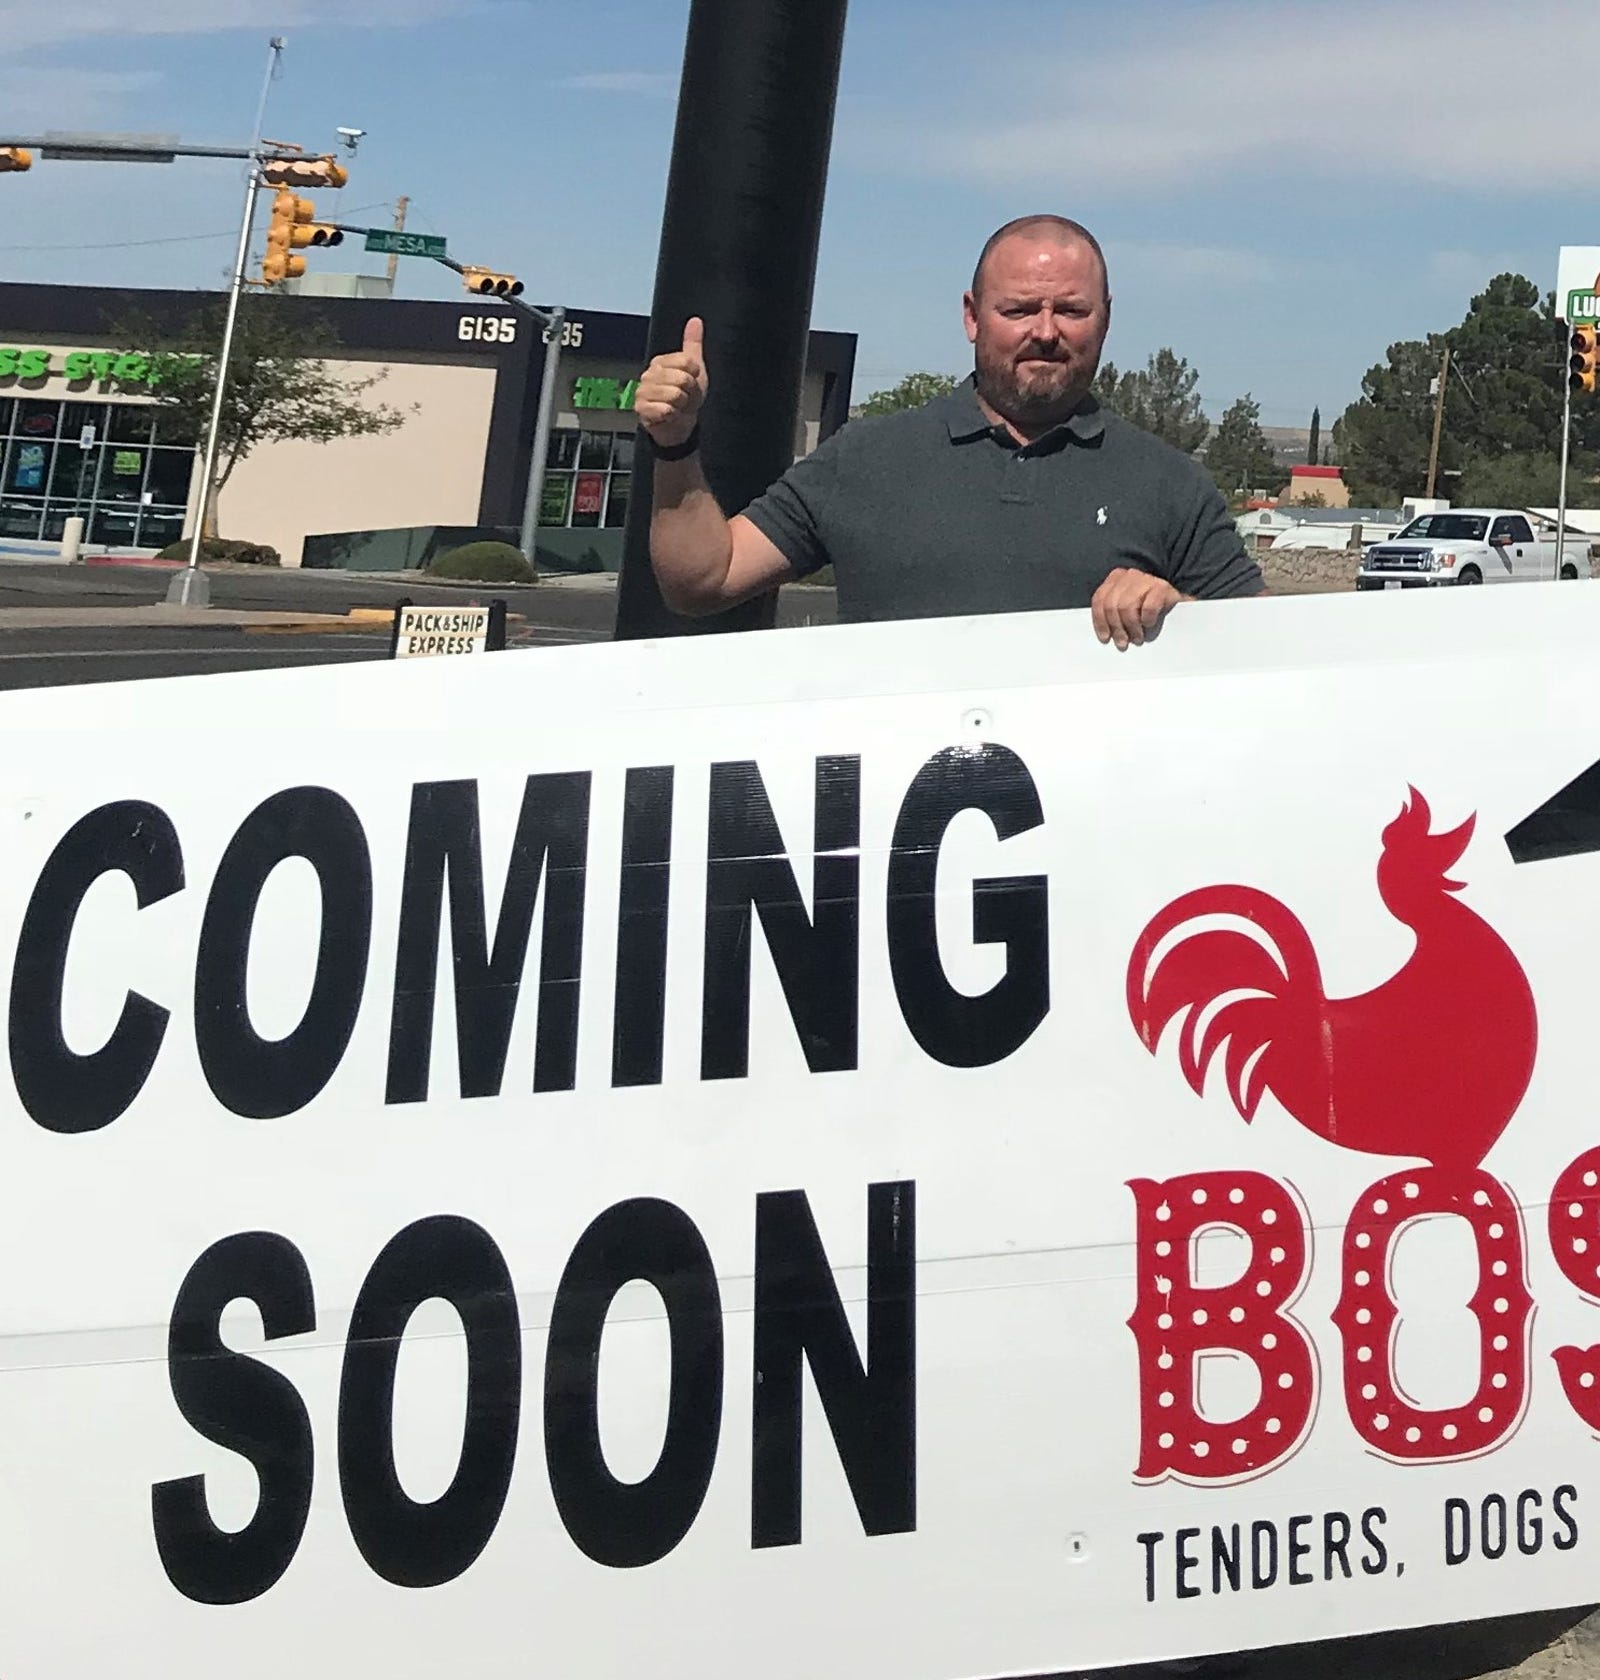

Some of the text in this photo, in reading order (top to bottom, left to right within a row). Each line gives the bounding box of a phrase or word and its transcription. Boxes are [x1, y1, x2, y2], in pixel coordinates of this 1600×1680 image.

[385, 234, 427, 254] MESA
[458, 316, 517, 343] 6135
[542, 322, 583, 347] 35
[408, 635, 475, 655] EXPRESS
[7, 740, 1051, 1134] COMING
[151, 1178, 918, 1606] SOON
[1136, 1507, 1406, 1604] TENDERS,
[1444, 1484, 1580, 1567] DOGS
